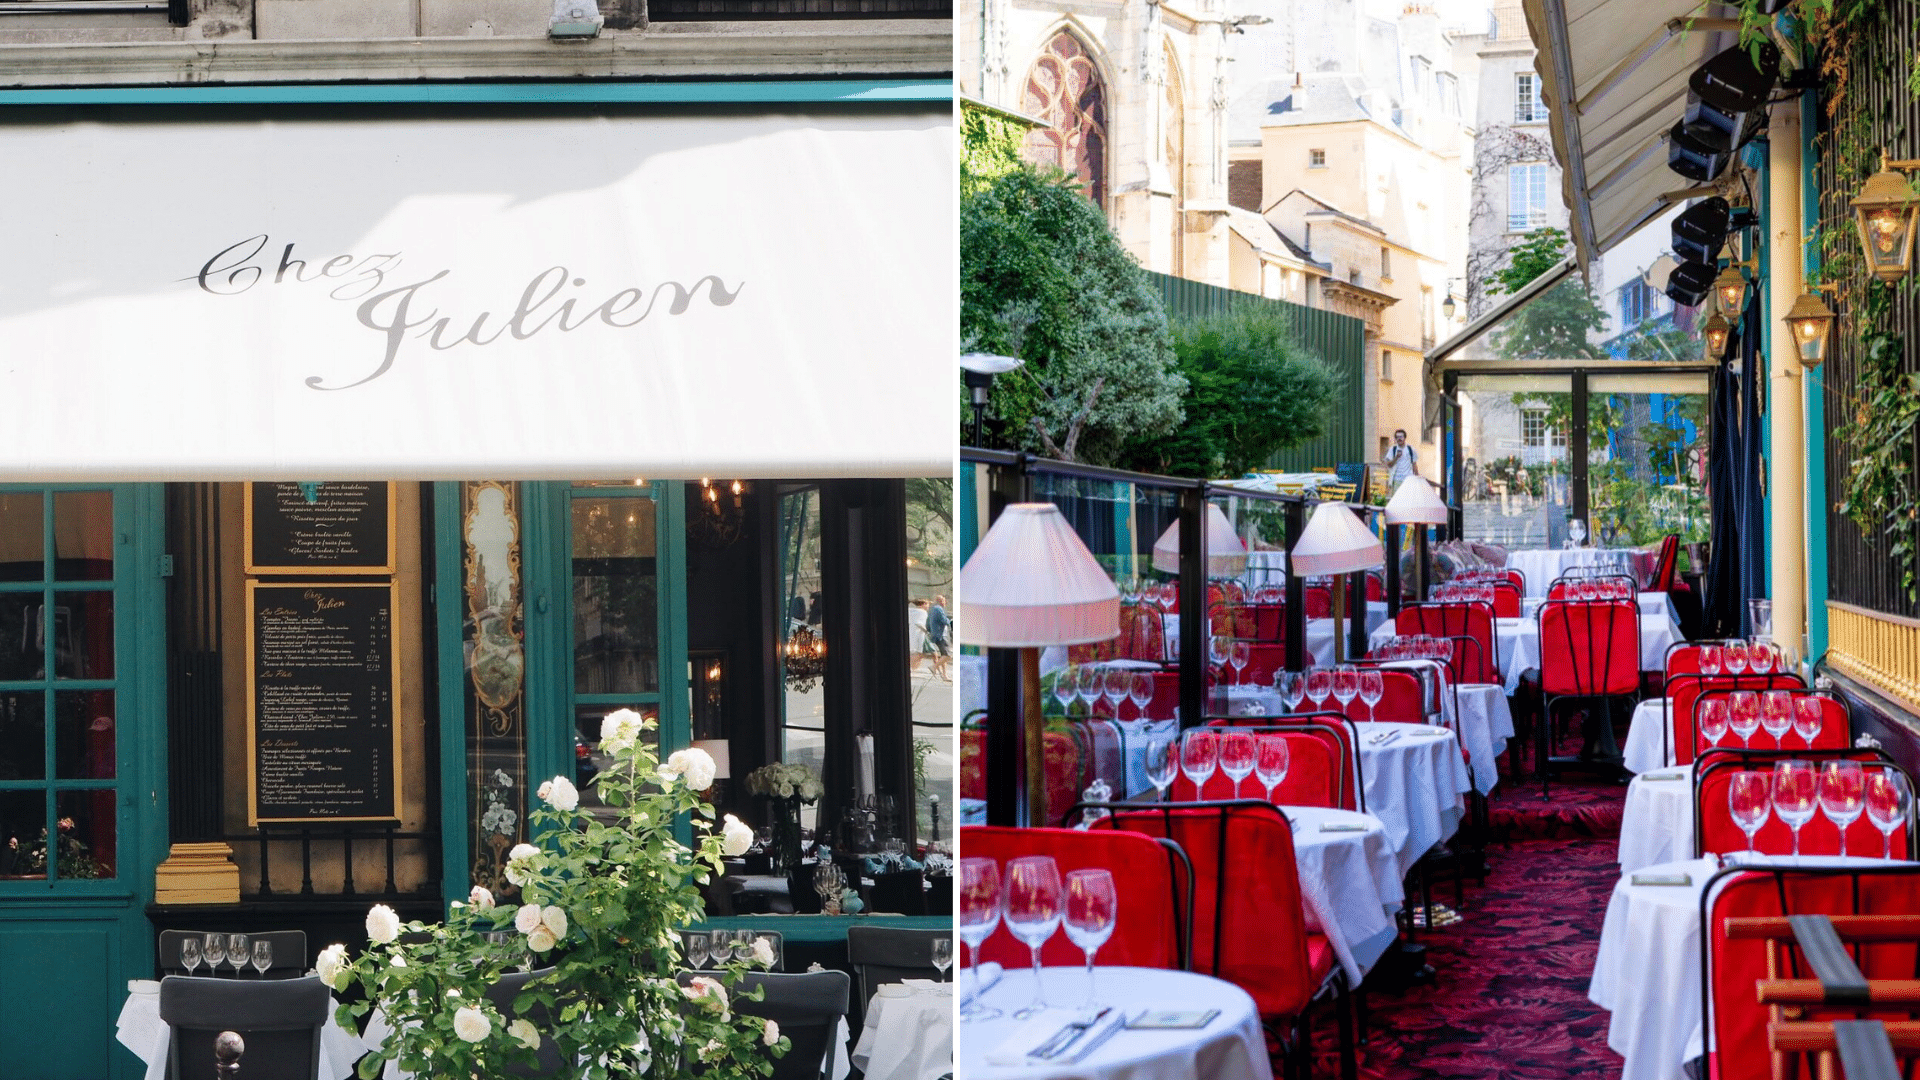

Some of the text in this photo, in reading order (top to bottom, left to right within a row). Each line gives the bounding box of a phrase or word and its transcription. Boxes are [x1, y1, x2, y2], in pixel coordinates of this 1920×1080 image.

[174, 233, 402, 299] Chez
[305, 265, 745, 391] Julien
[304, 589, 322, 601] Chez
[312, 598, 345, 613] Julien
[274, 670, 292, 678] Plats
